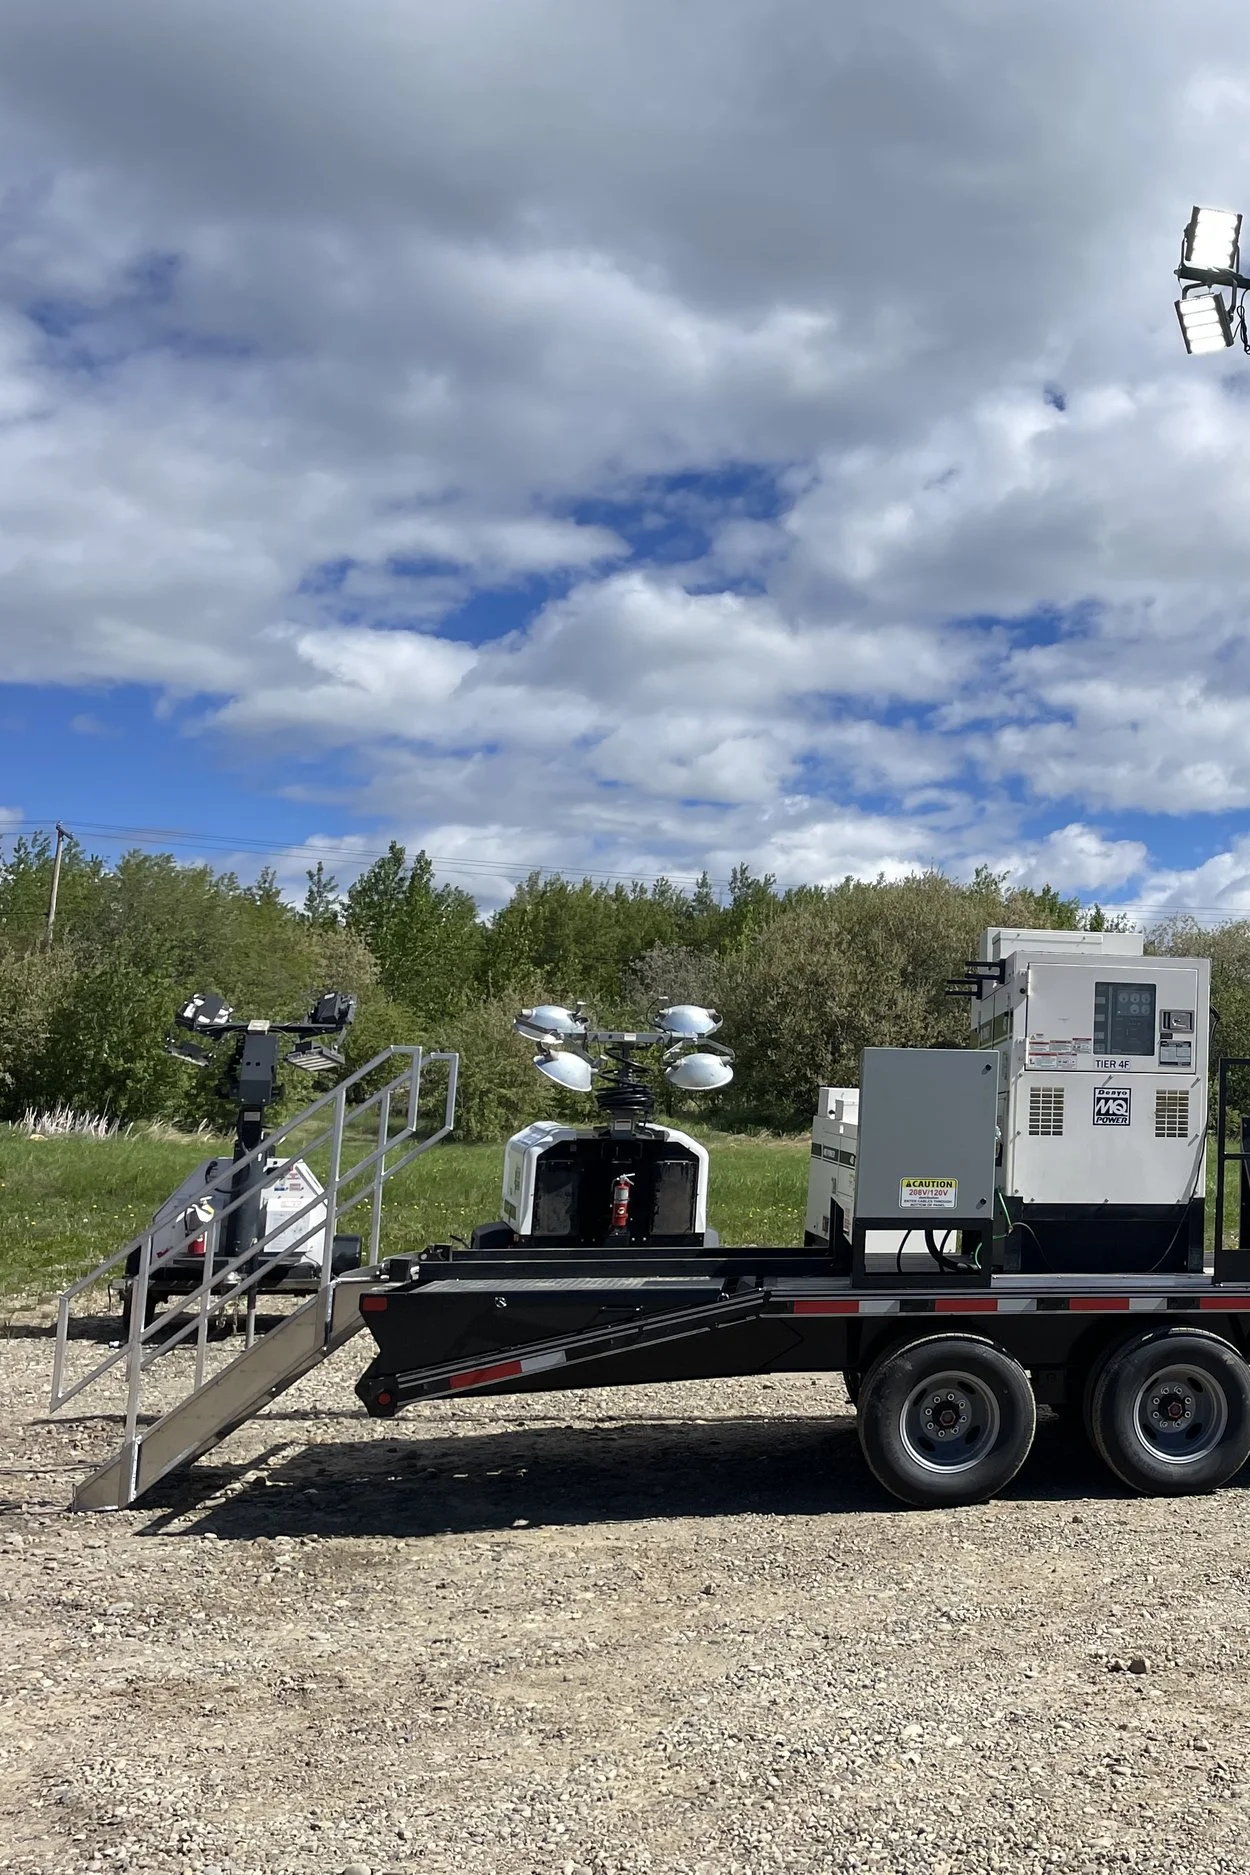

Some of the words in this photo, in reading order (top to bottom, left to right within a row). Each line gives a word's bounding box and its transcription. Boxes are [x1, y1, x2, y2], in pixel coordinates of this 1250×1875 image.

[1095, 1059, 1117, 1068] TIER
[1118, 1060, 1130, 1069] 4F
[1097, 1089, 1128, 1097] Denyo
[1096, 1098, 1128, 1116] MQ
[1096, 1116, 1128, 1124] POWER
[912, 1180, 953, 1188] CAUTION
